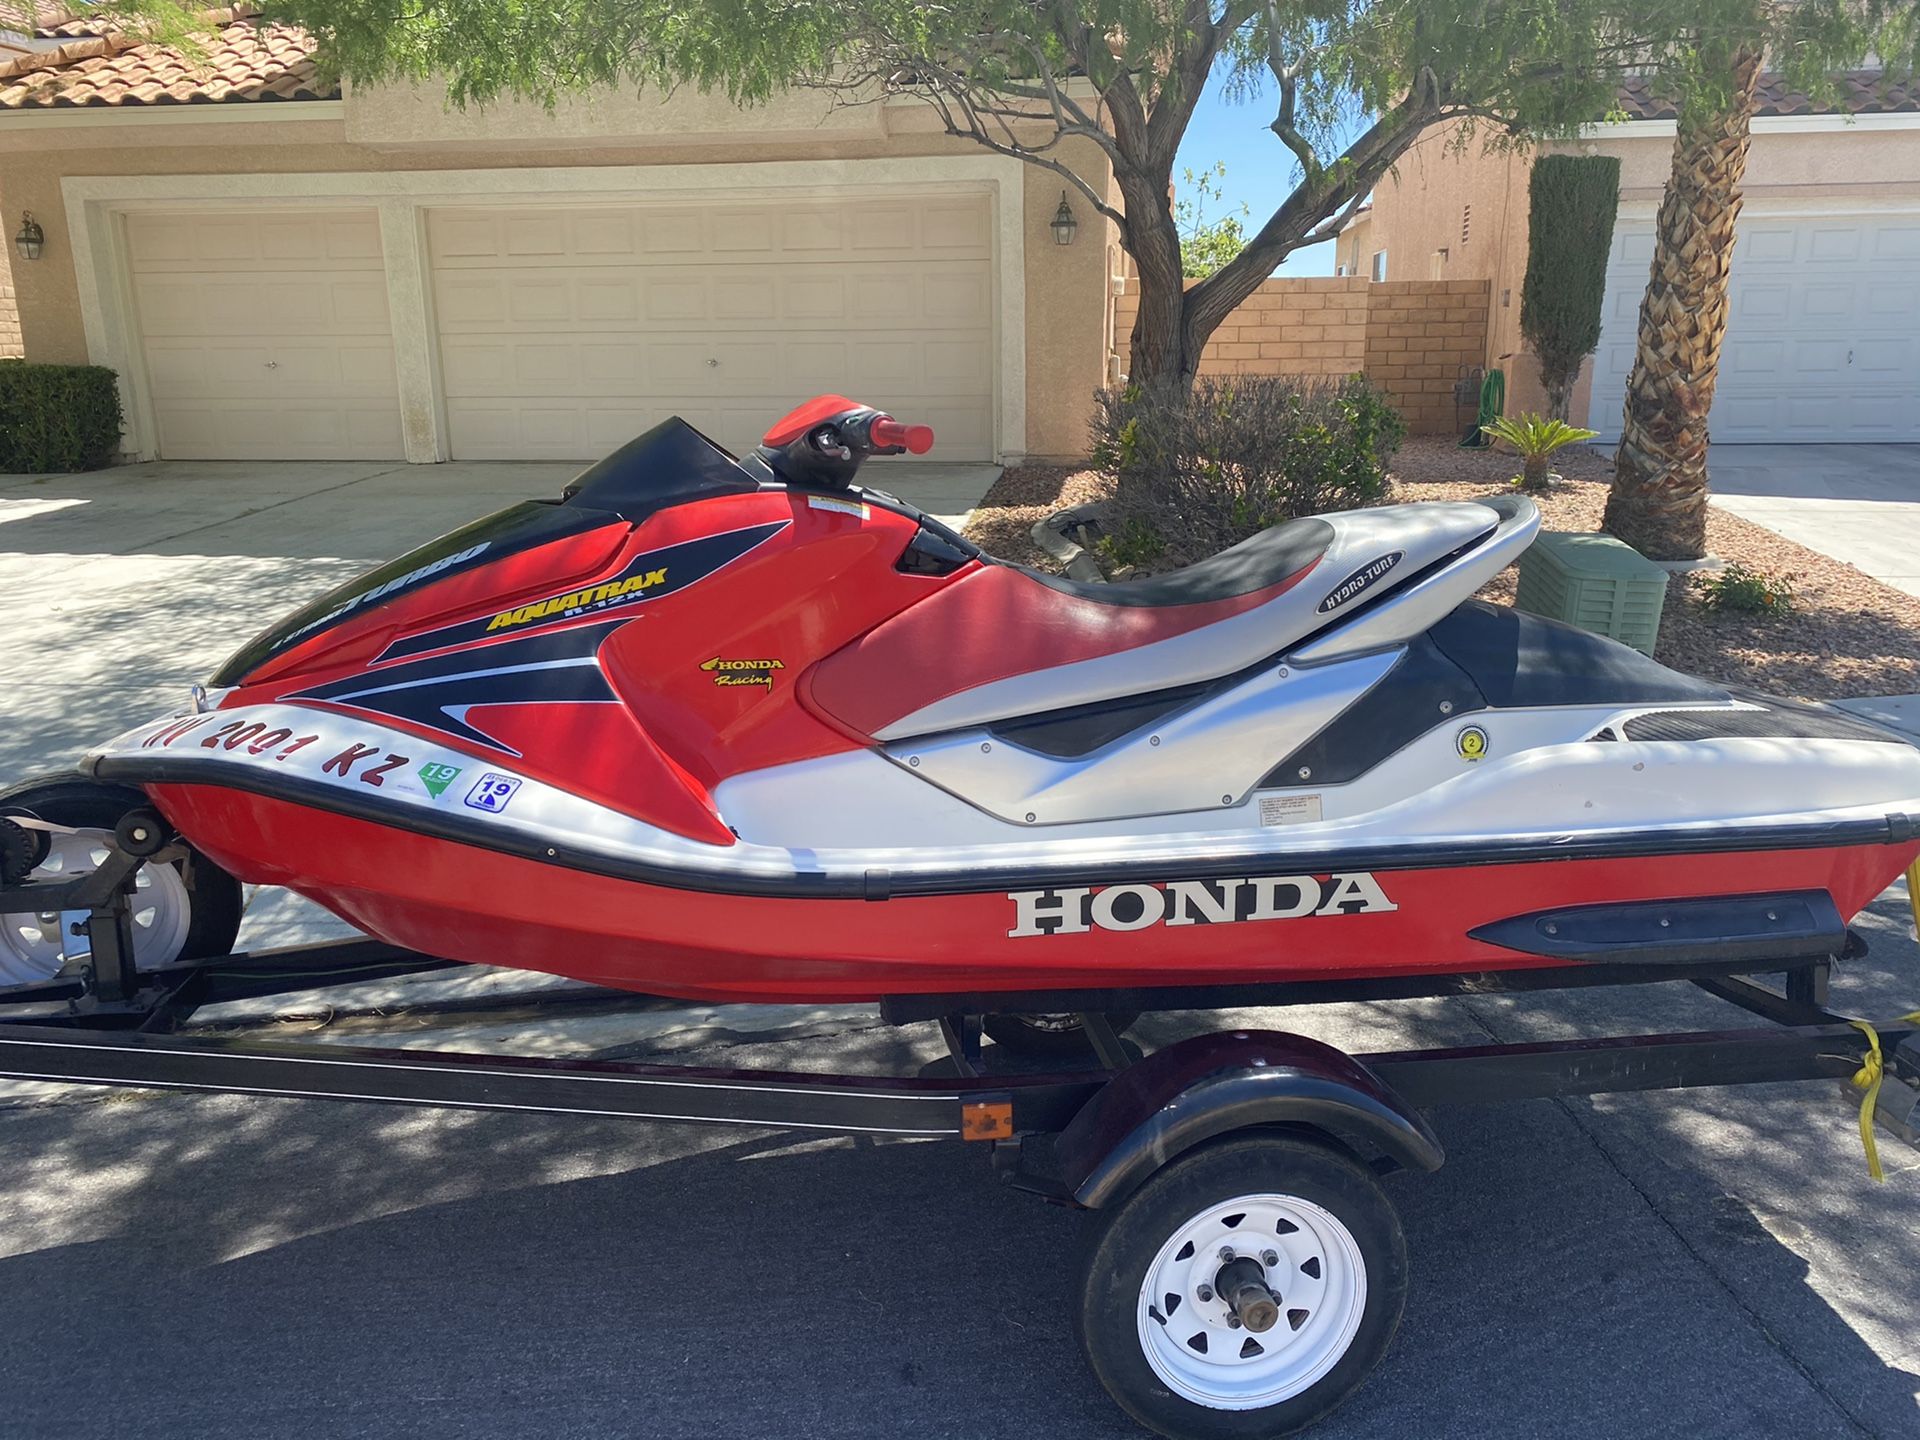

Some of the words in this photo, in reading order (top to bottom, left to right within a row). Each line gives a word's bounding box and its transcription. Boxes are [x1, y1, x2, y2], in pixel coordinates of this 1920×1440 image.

[333, 541, 492, 613] TURBO
[1325, 555, 1395, 609] HYDRO-TURF
[486, 568, 668, 631] AQUATRAX
[718, 659, 785, 670] HONDA
[714, 674, 773, 692] Racing
[200, 720, 320, 762] 2001
[1468, 737, 1475, 747] 2
[427, 764, 456, 780] 19
[482, 780, 511, 796] 19
[1007, 872, 1399, 938] HONDA
